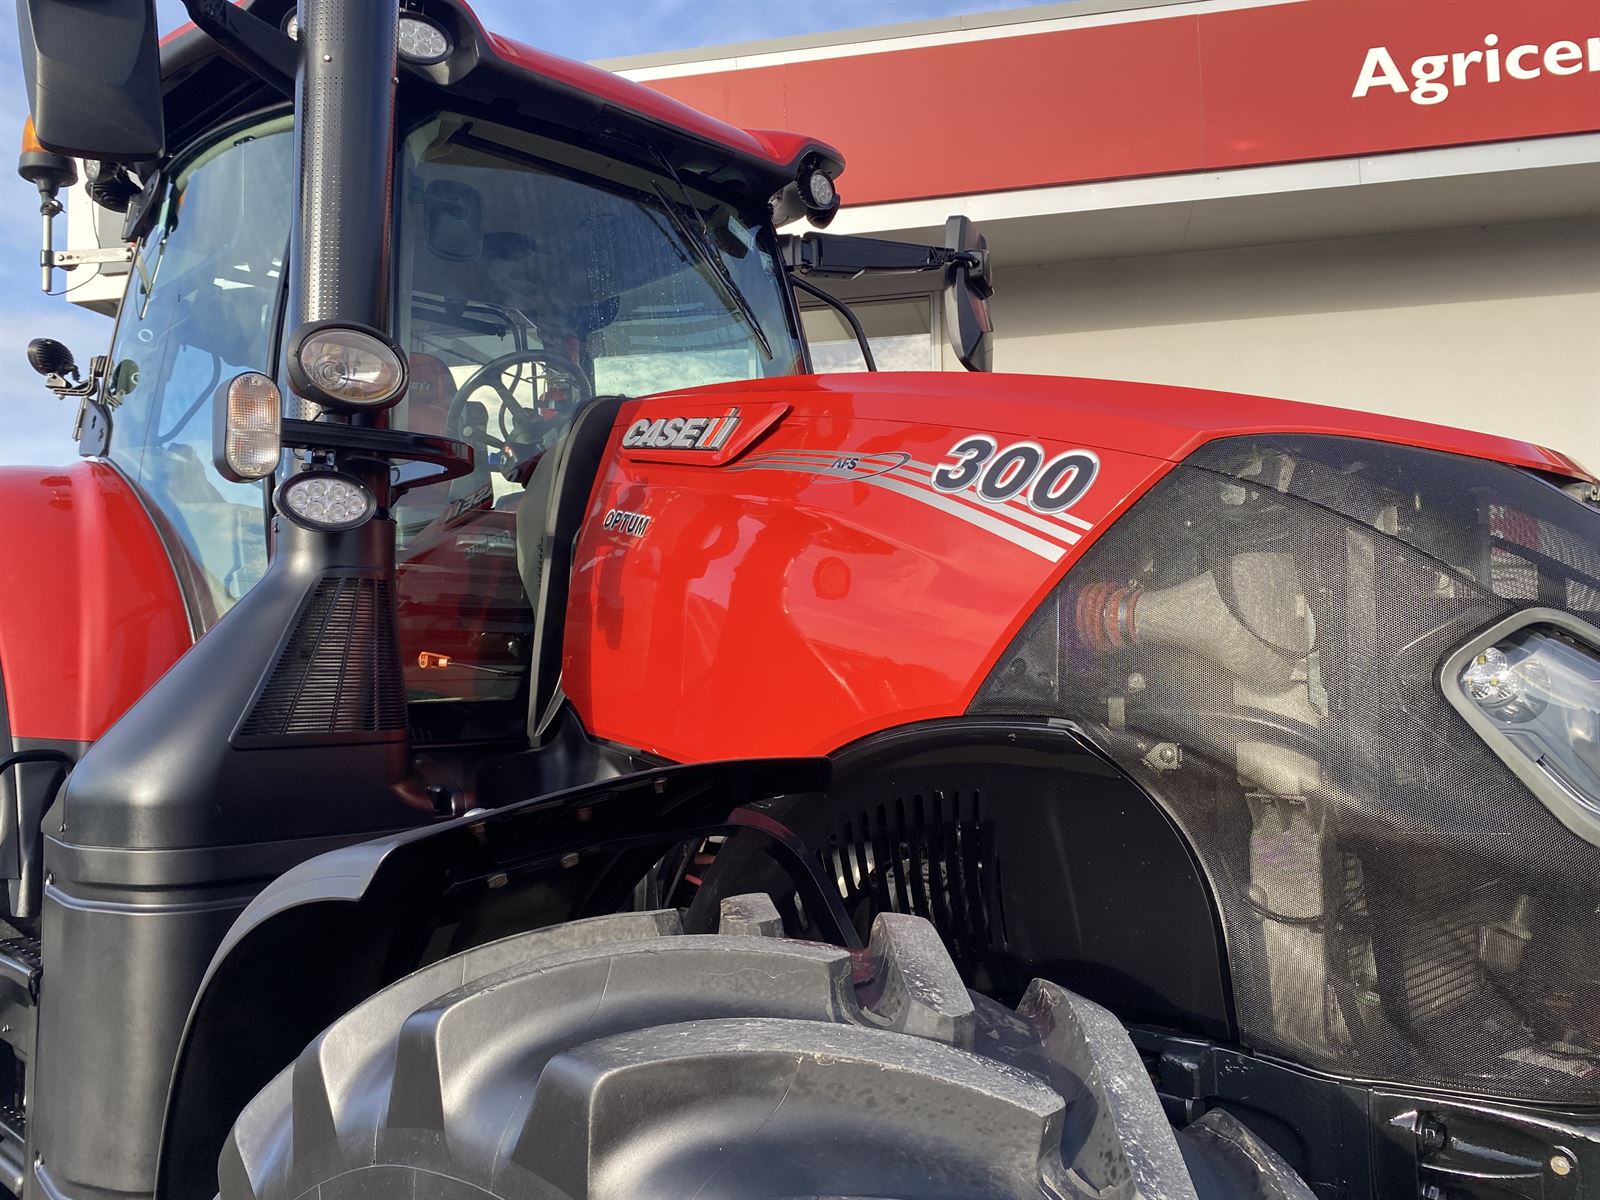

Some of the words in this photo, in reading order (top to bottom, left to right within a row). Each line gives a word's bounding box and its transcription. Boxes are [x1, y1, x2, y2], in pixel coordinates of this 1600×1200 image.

[831, 456, 859, 470] AFS
[930, 434, 1100, 514] 300
[603, 509, 651, 538] OPTUM
